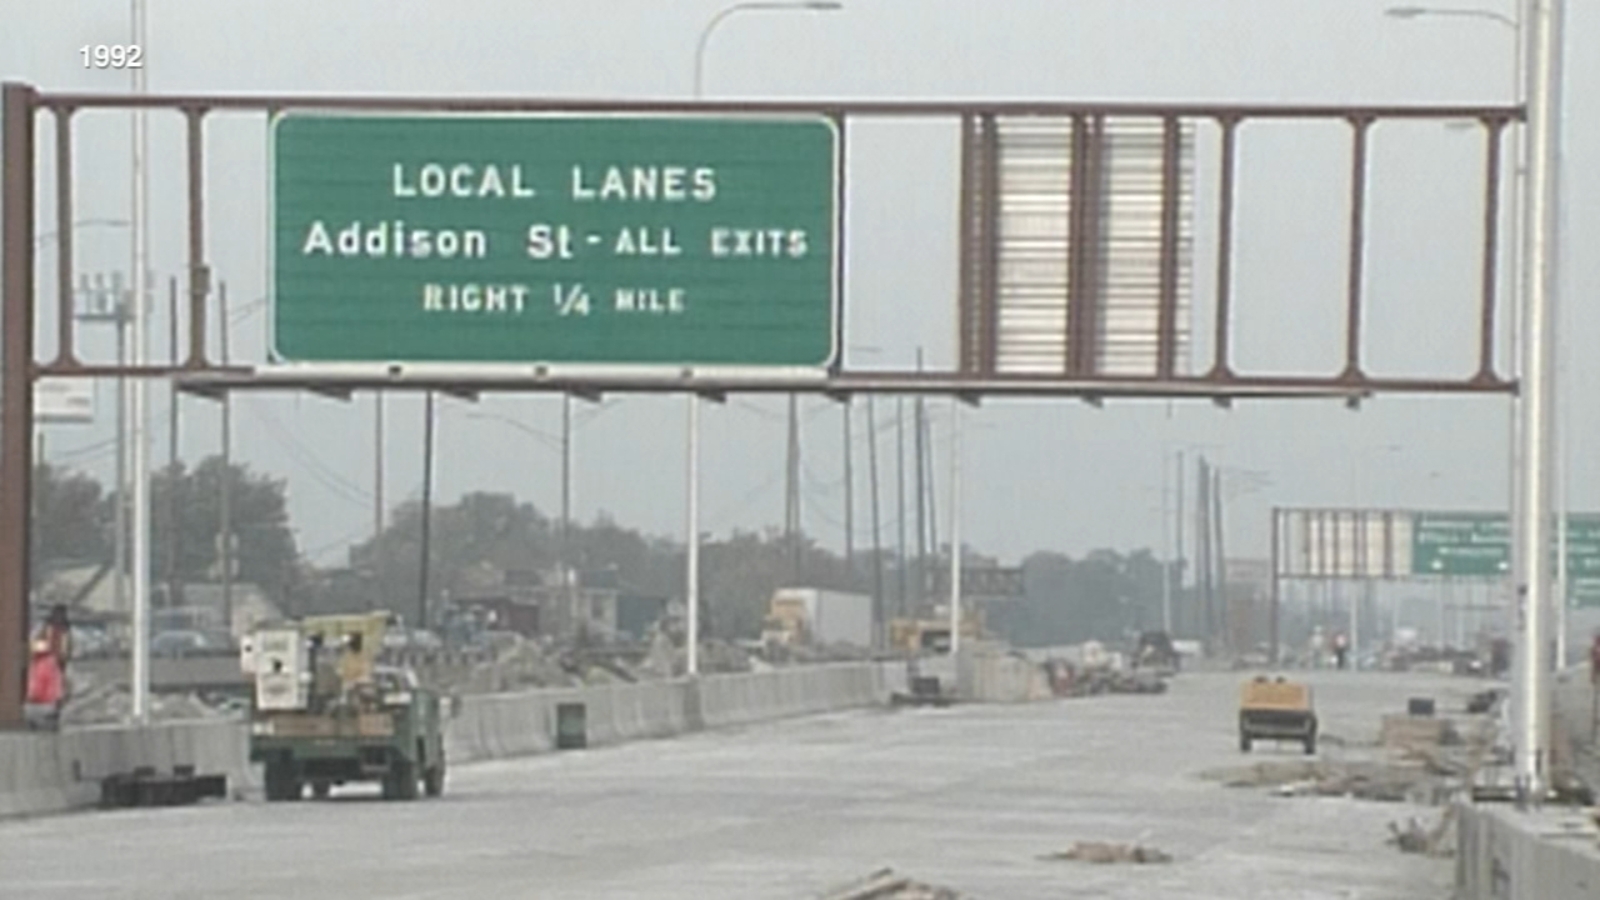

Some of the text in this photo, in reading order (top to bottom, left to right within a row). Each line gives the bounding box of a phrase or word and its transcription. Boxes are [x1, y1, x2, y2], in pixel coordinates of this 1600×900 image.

[393, 163, 717, 201] LOCAL LANES
[303, 220, 487, 258] Addison
[526, 223, 573, 259] St
[614, 228, 681, 256] ALL
[710, 228, 808, 257] EXITS
[423, 284, 528, 312] RIGHT
[614, 288, 685, 312] MILE
